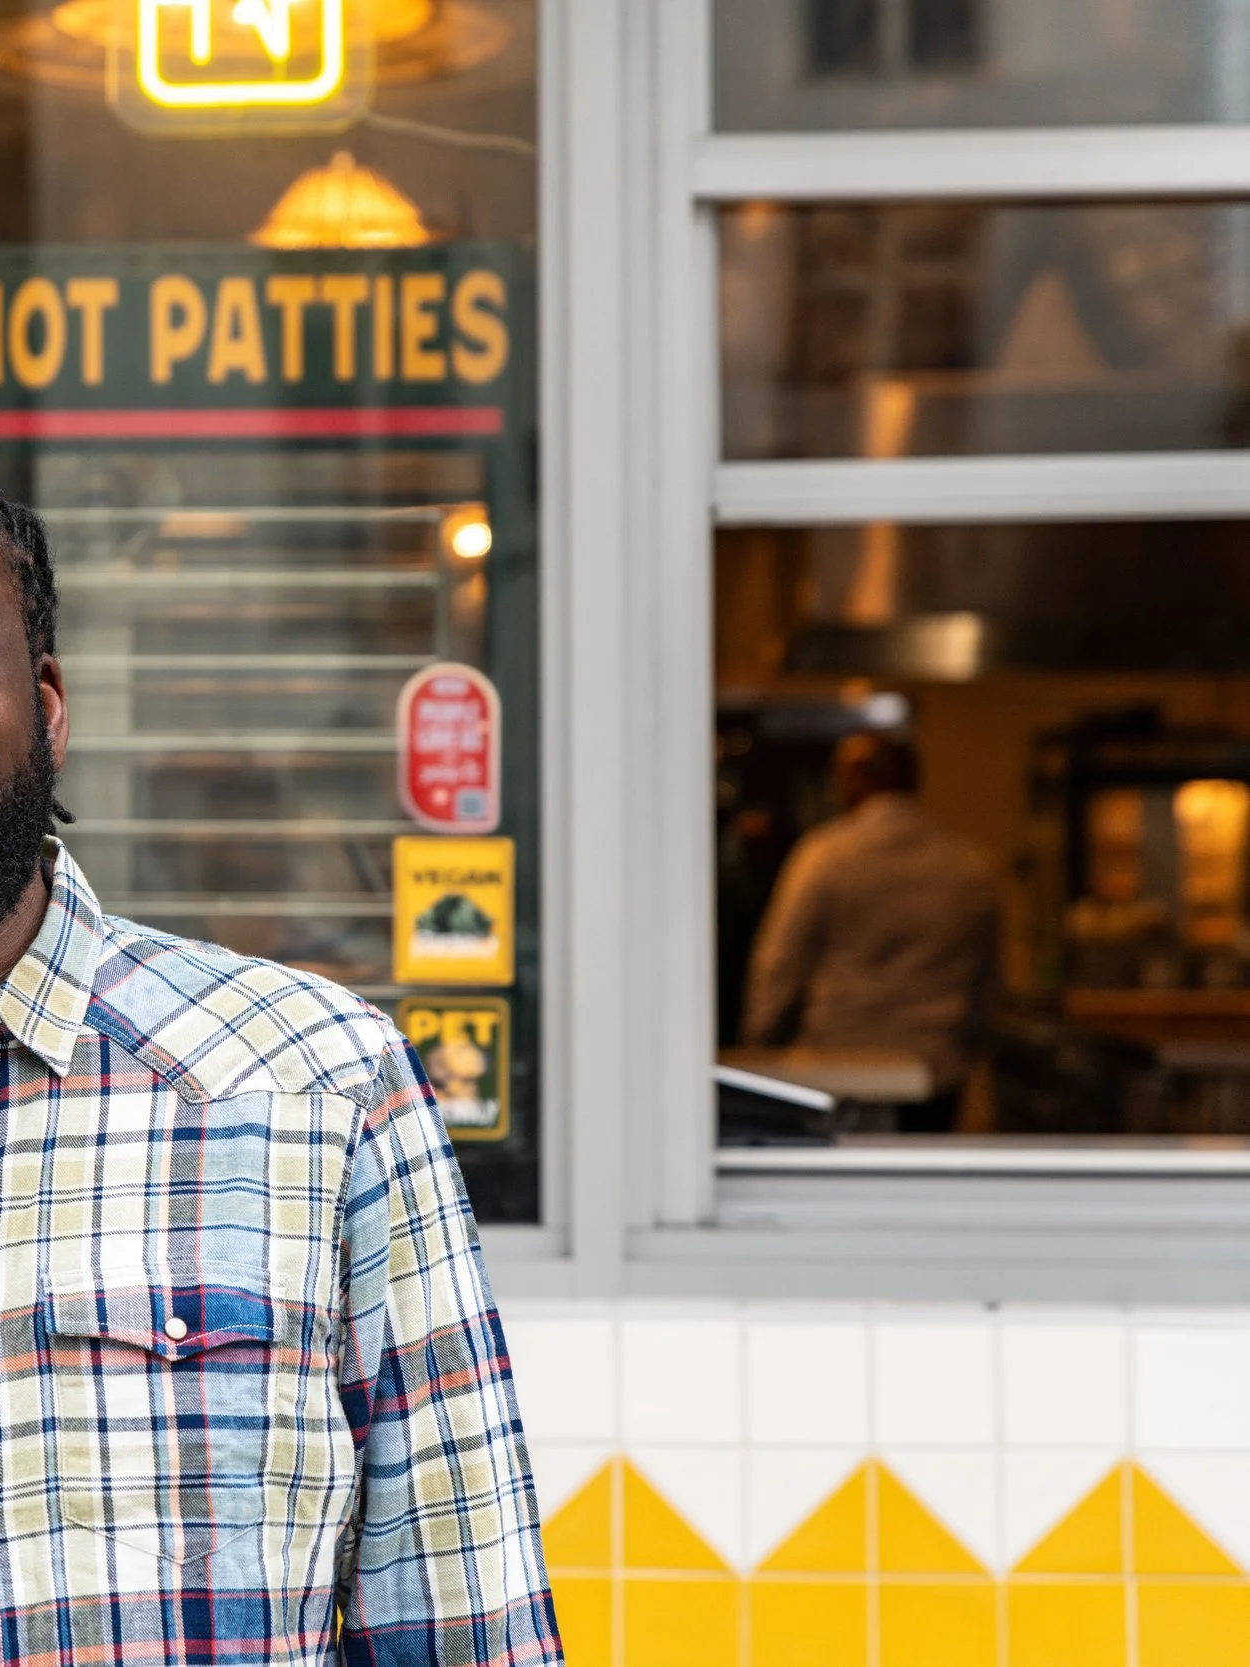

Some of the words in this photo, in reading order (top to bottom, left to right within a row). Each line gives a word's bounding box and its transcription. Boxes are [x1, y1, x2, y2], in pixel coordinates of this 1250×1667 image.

[150, 270, 509, 385] PATTIES
[412, 867, 502, 887] VEGAN
[409, 1009, 499, 1046] PET
